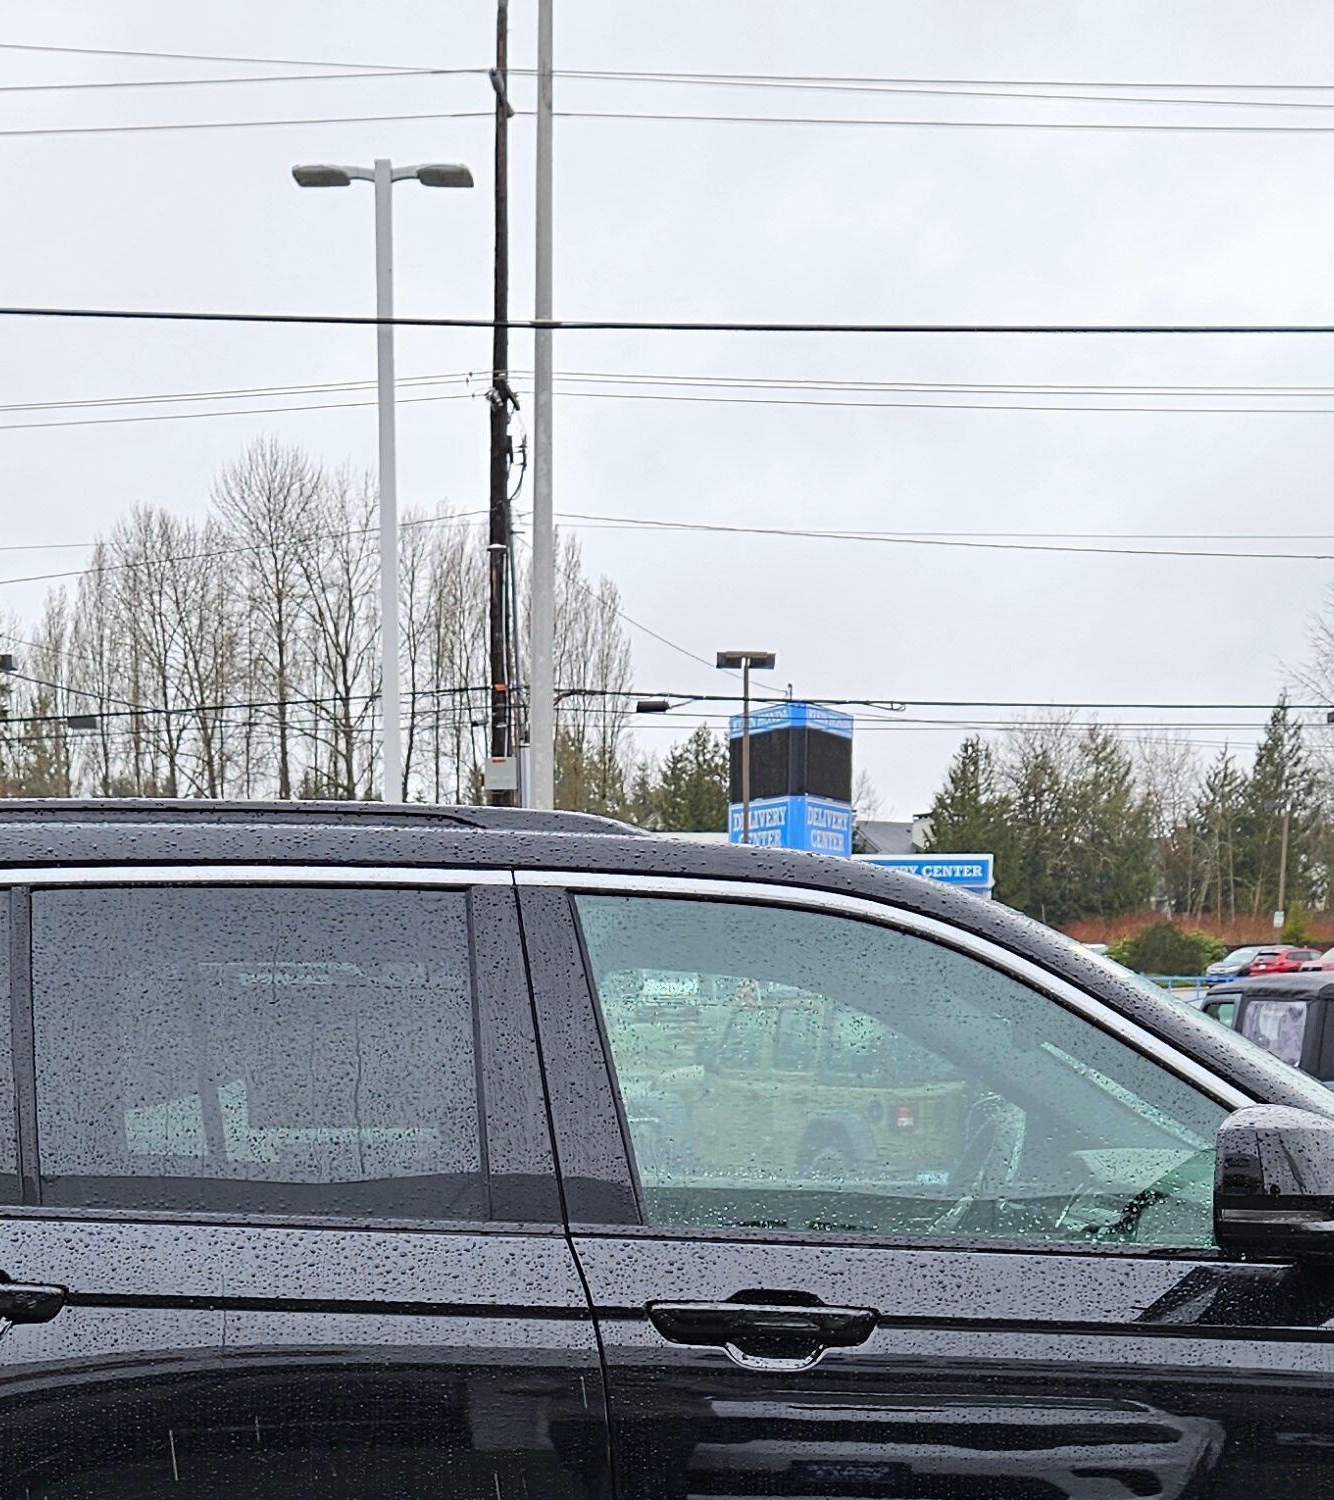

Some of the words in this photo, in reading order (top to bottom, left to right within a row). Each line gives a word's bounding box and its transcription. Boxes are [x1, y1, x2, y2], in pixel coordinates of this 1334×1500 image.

[733, 806, 787, 831] DLIVERY
[807, 806, 848, 831] DELIVERY
[811, 829, 844, 851] CENTER
[921, 865, 982, 877] CENTER
